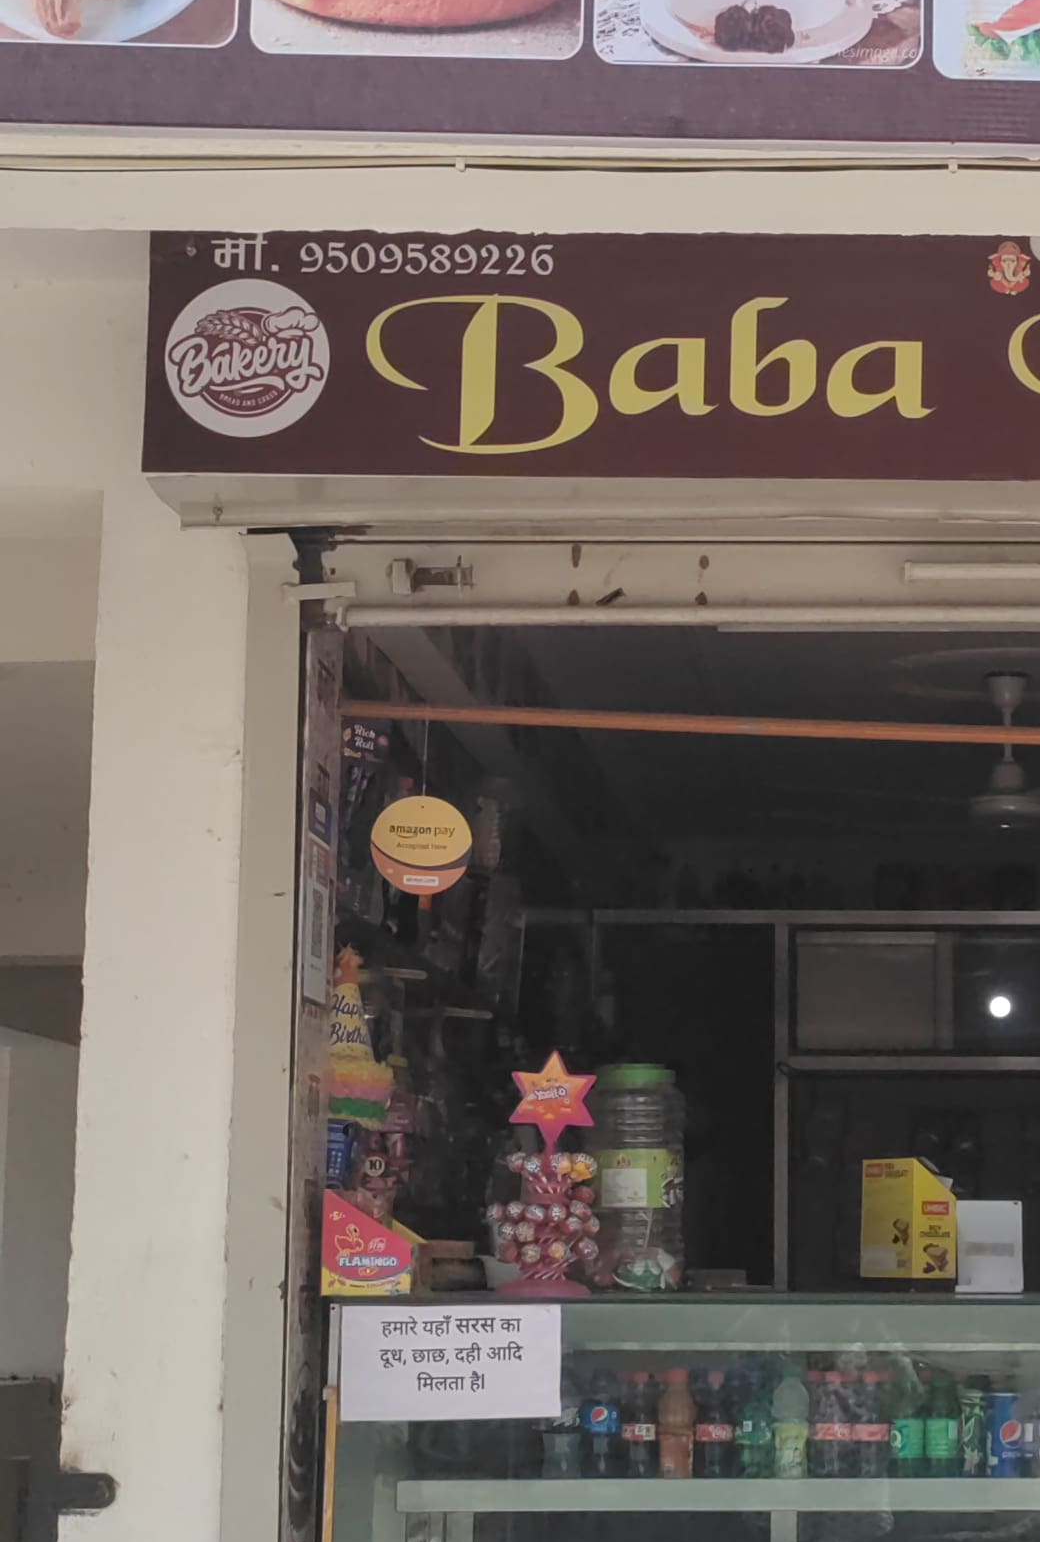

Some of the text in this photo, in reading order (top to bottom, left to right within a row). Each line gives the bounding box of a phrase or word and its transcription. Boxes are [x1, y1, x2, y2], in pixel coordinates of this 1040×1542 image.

[300, 242, 554, 275] 9509589226
[170, 332, 323, 396] Bakery
[365, 293, 936, 454] Baba
[389, 825, 456, 838] amazon pay
[367, 1159, 382, 1171] 10
[339, 1256, 397, 1268] FLAMINGO
[381, 1315, 522, 1337] हमारे यहाँ सरस का
[380, 1341, 523, 1368] दूध, छाछ, दही आदि
[417, 1372, 465, 1391] मिलता
